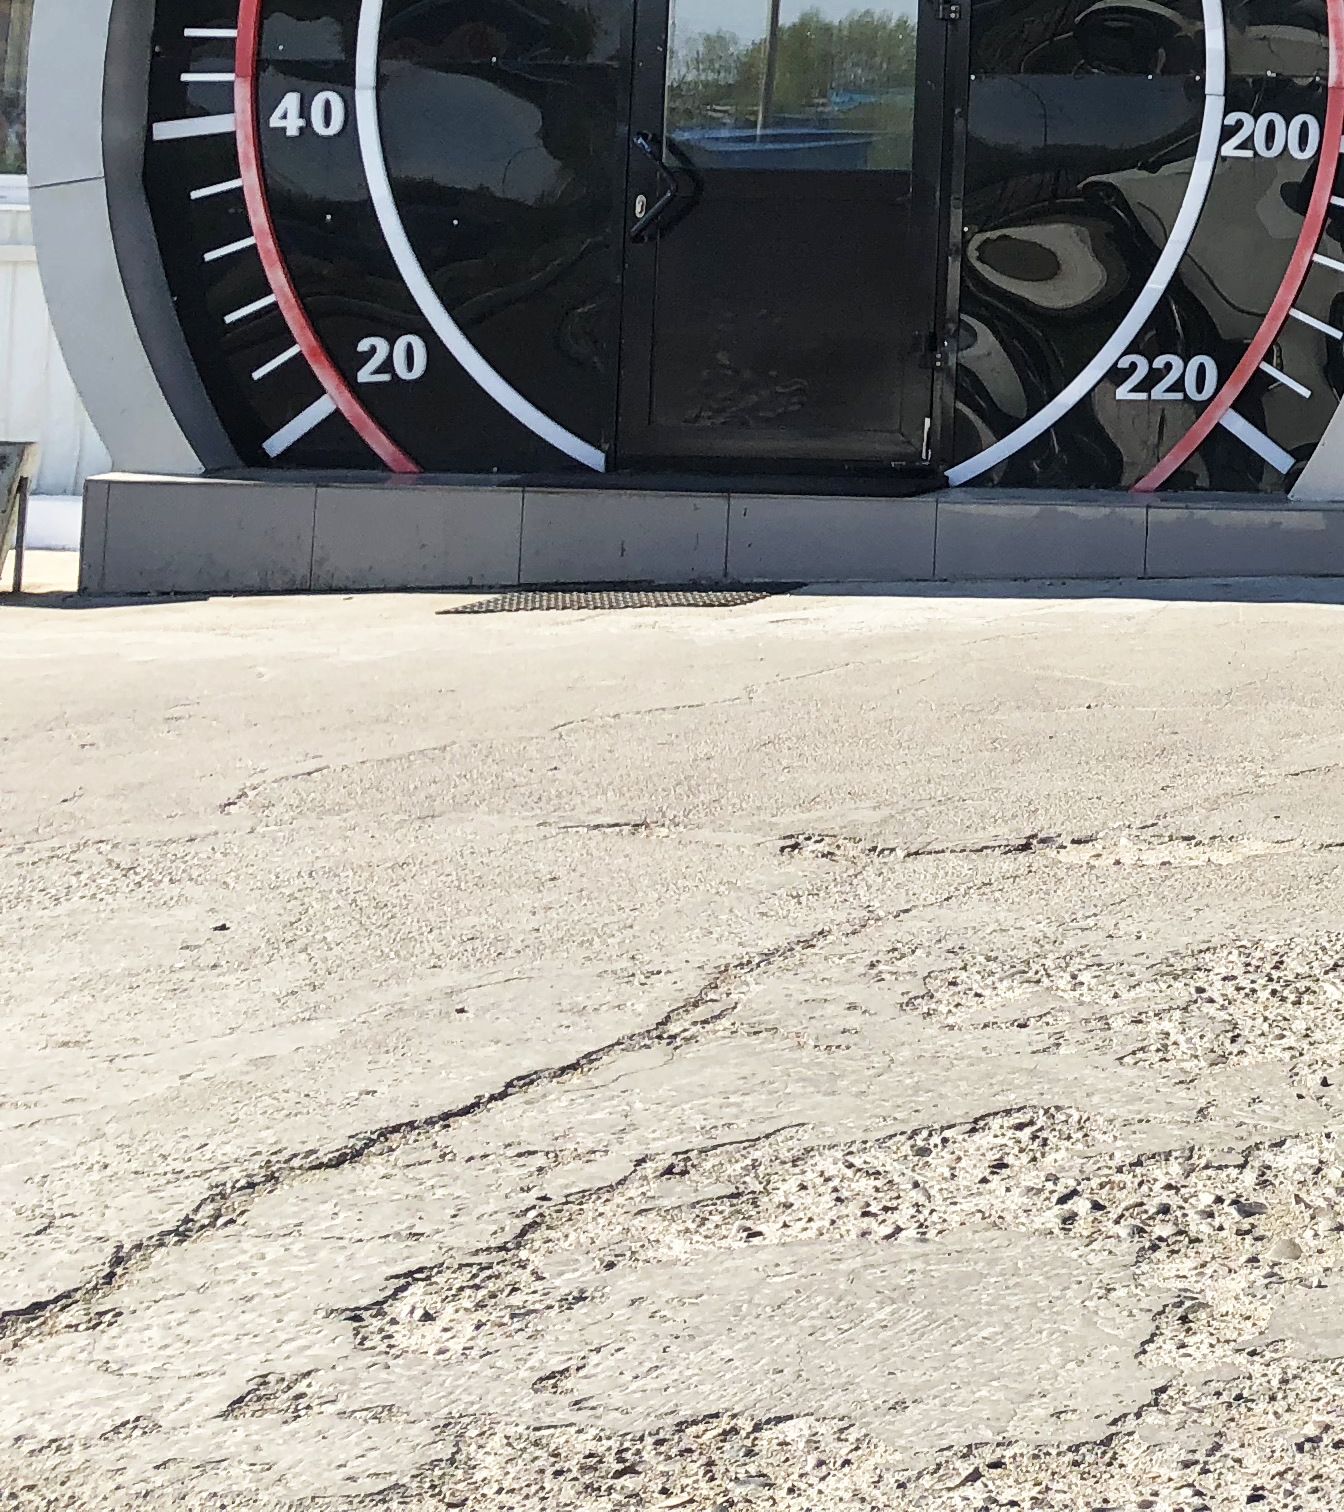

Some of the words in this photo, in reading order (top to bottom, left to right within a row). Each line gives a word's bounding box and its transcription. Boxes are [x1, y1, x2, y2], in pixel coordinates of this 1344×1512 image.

[269, 90, 345, 137] 40
[1220, 111, 1320, 160] 200
[356, 333, 428, 383] 20
[1115, 353, 1218, 402] 220
